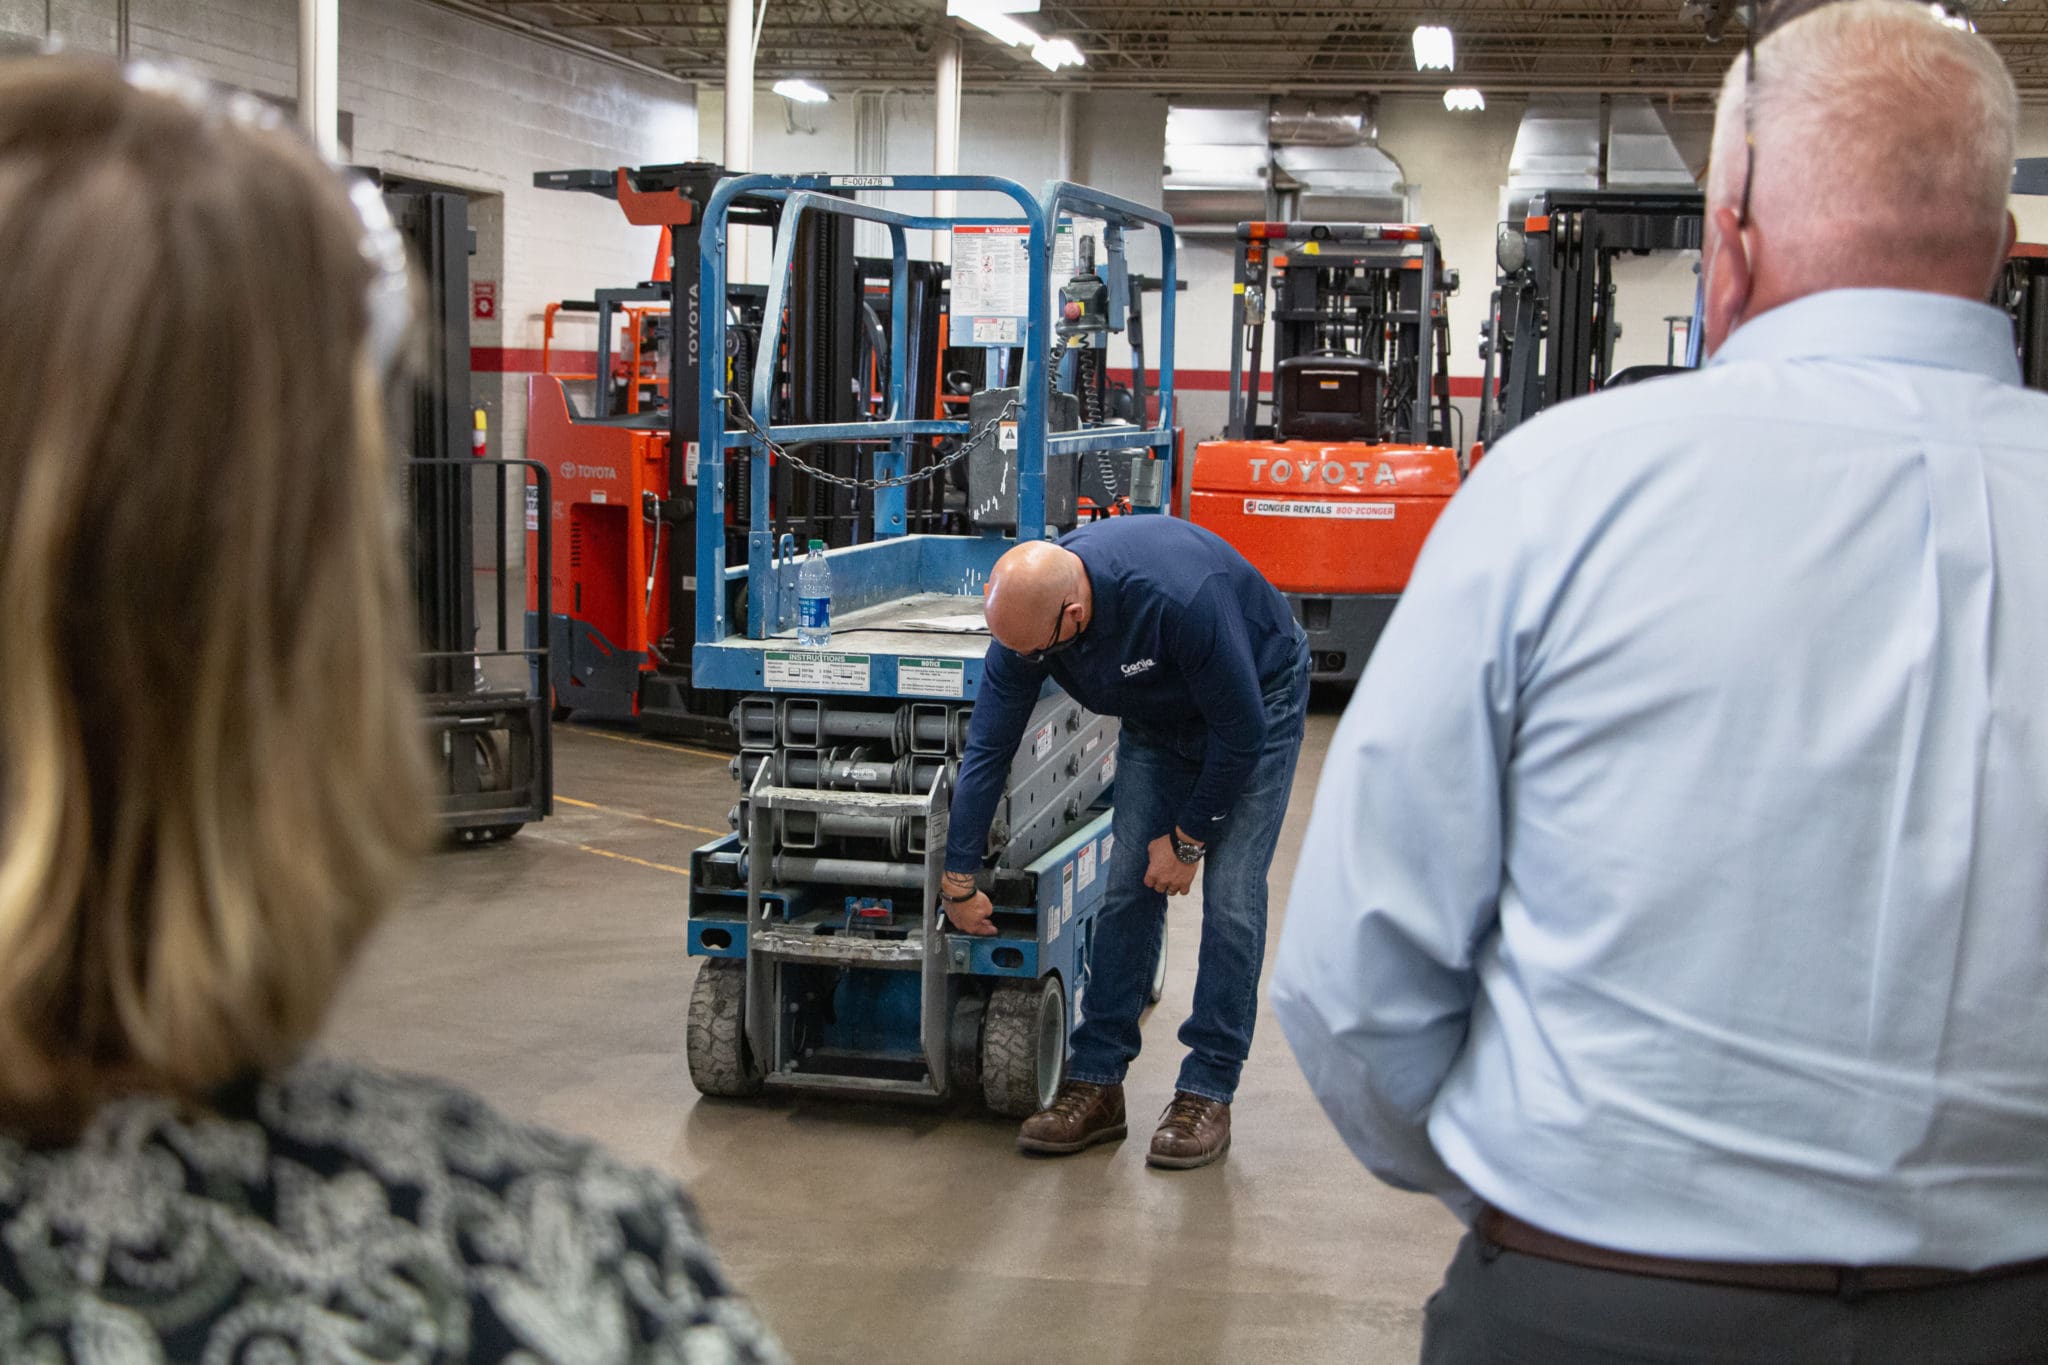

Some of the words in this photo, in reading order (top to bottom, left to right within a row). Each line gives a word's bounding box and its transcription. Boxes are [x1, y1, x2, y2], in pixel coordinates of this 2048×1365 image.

[842, 177, 883, 186] E-007478
[688, 283, 699, 367] TOYOTA
[577, 464, 617, 479] TOYOTA
[1249, 458, 1397, 486] TOYOTA
[1257, 503, 1291, 513] CONGER
[1293, 504, 1332, 514] RENTALS
[1336, 506, 1393, 516] 800-2CONGER
[789, 653, 846, 663] INSTRUCTIONS
[1120, 658, 1157, 674] Genie
